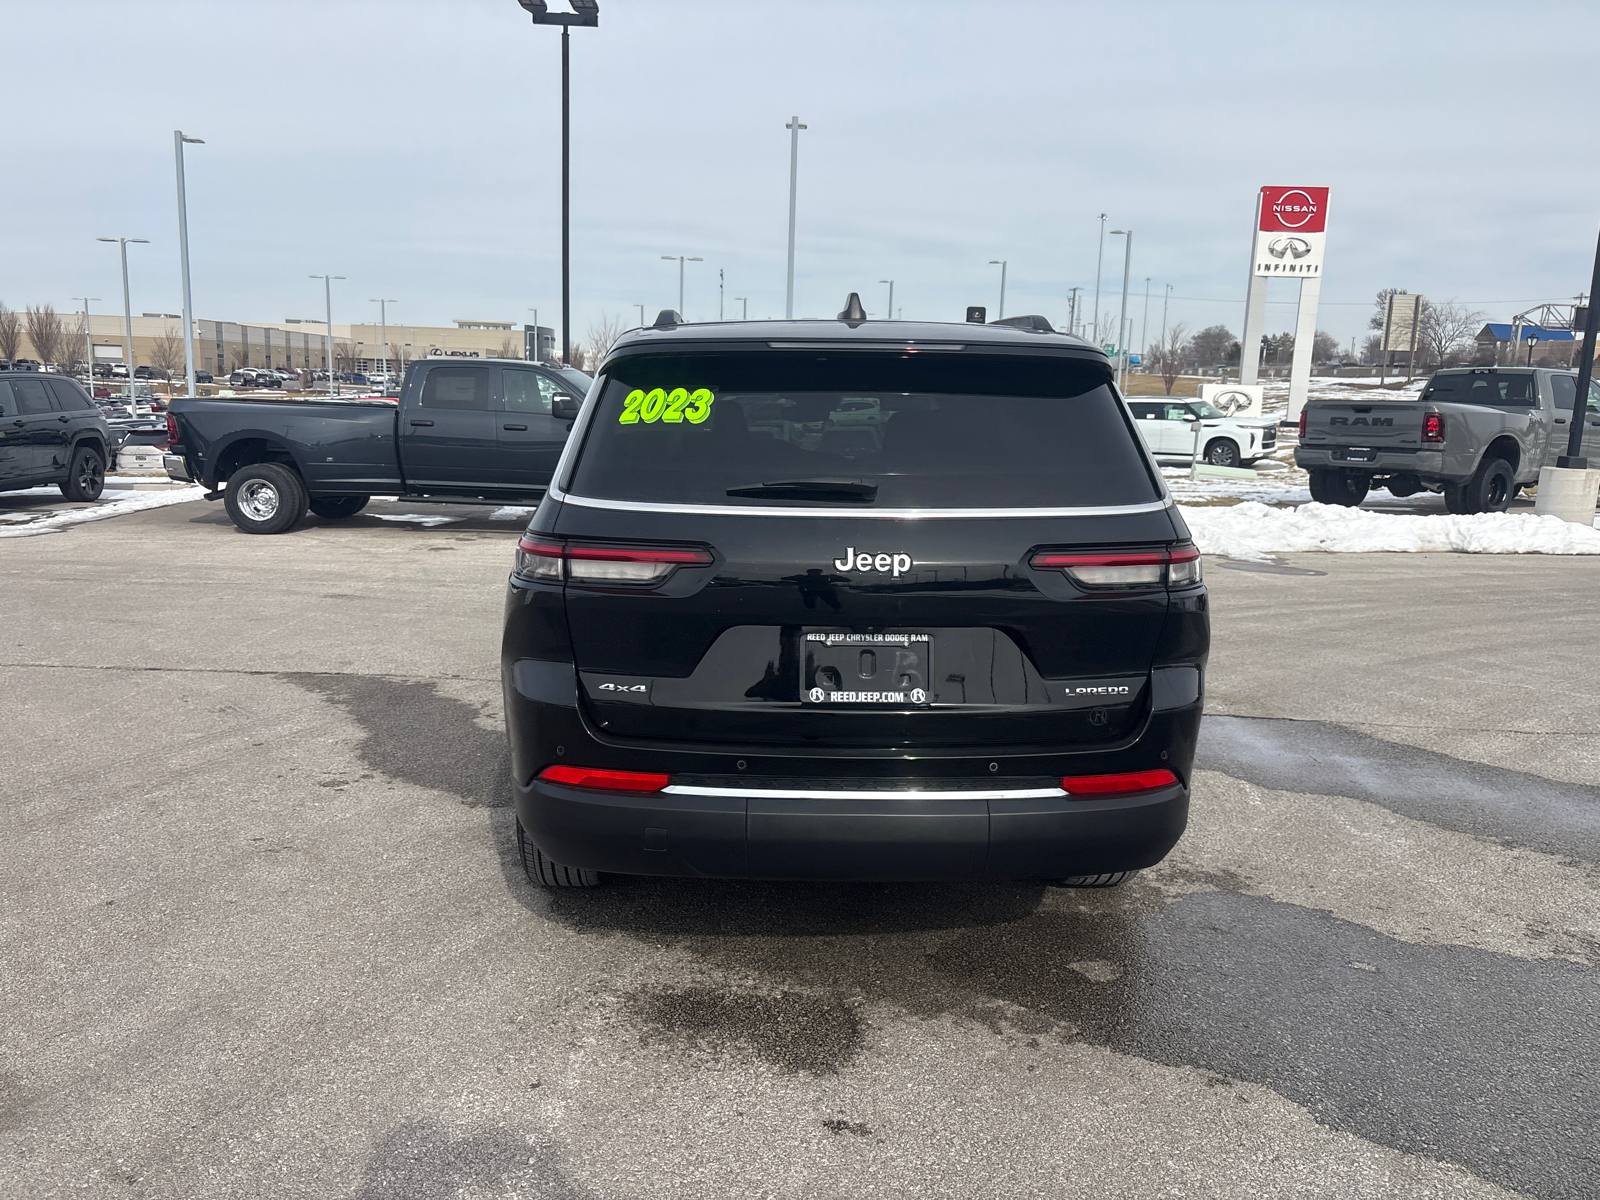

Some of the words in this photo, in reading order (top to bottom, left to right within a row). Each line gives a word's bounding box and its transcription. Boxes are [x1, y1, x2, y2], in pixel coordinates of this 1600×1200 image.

[1273, 205, 1317, 213] NISSAN
[1257, 263, 1319, 273] INFINITI
[619, 388, 714, 425] 2023
[1330, 417, 1394, 426] RAM
[834, 547, 912, 577] Jeep
[807, 633, 826, 641] REED
[827, 633, 845, 641] JEEP
[846, 634, 883, 642] CHRYSLER
[884, 634, 909, 642] DODGE
[910, 634, 928, 642] RAM
[598, 683, 647, 692] 4x4
[1065, 686, 1129, 696] LAREDO
[830, 691, 904, 703] REEDJEEP.COM
